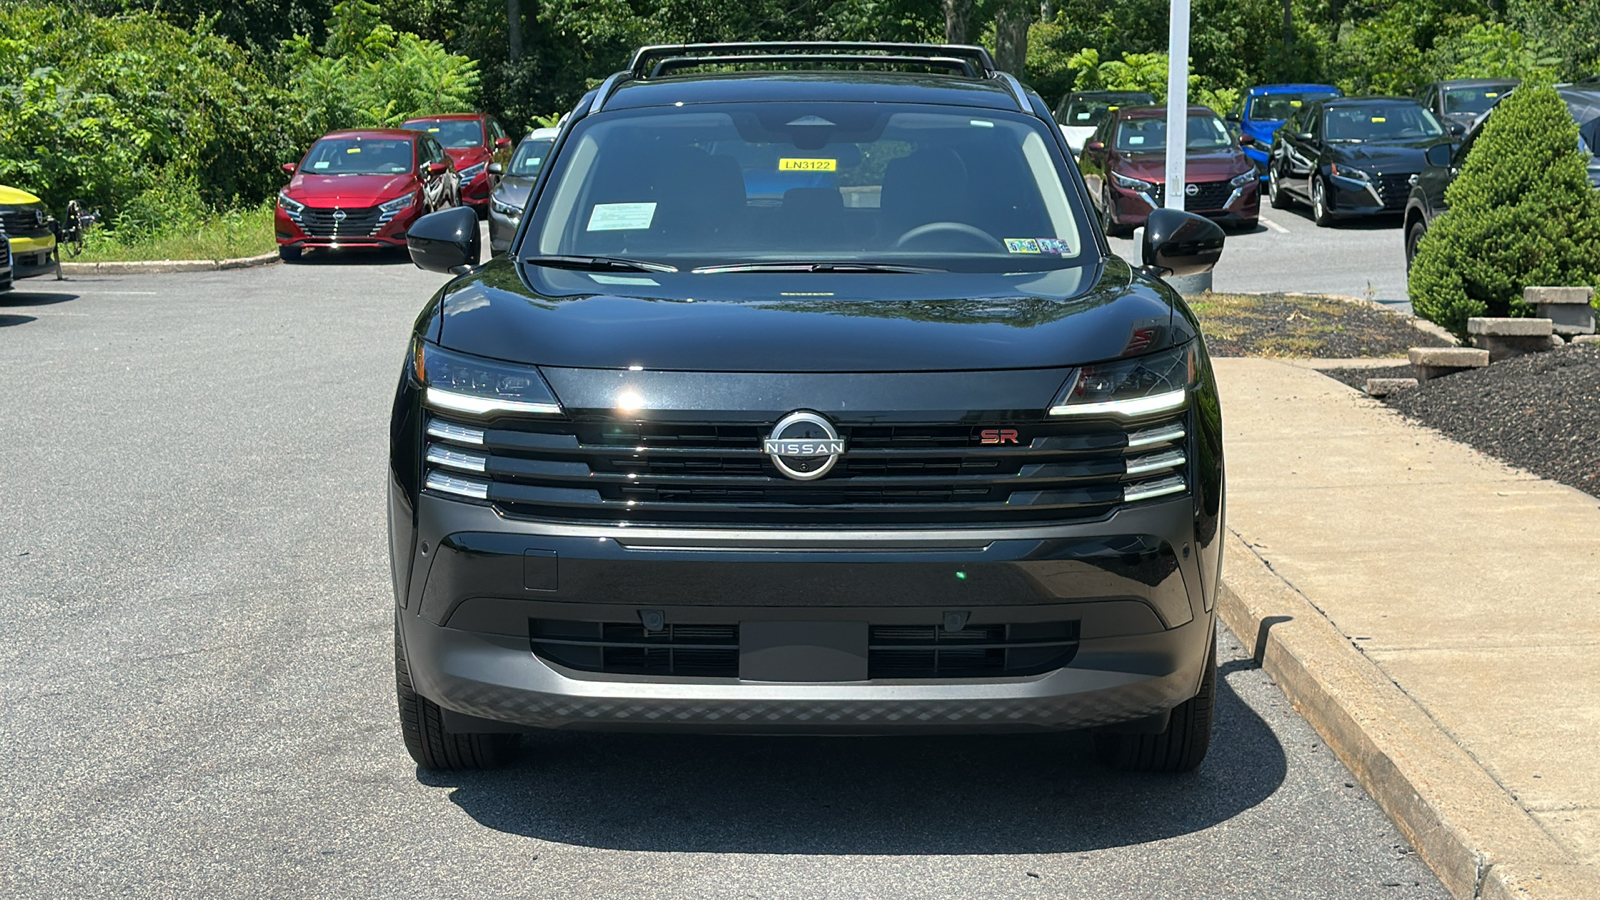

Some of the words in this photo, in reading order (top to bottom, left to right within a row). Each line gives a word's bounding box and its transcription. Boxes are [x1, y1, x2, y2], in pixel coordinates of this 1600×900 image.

[785, 161, 830, 170] LN3122
[981, 429, 1019, 444] SR
[766, 442, 843, 453] NISSAN
